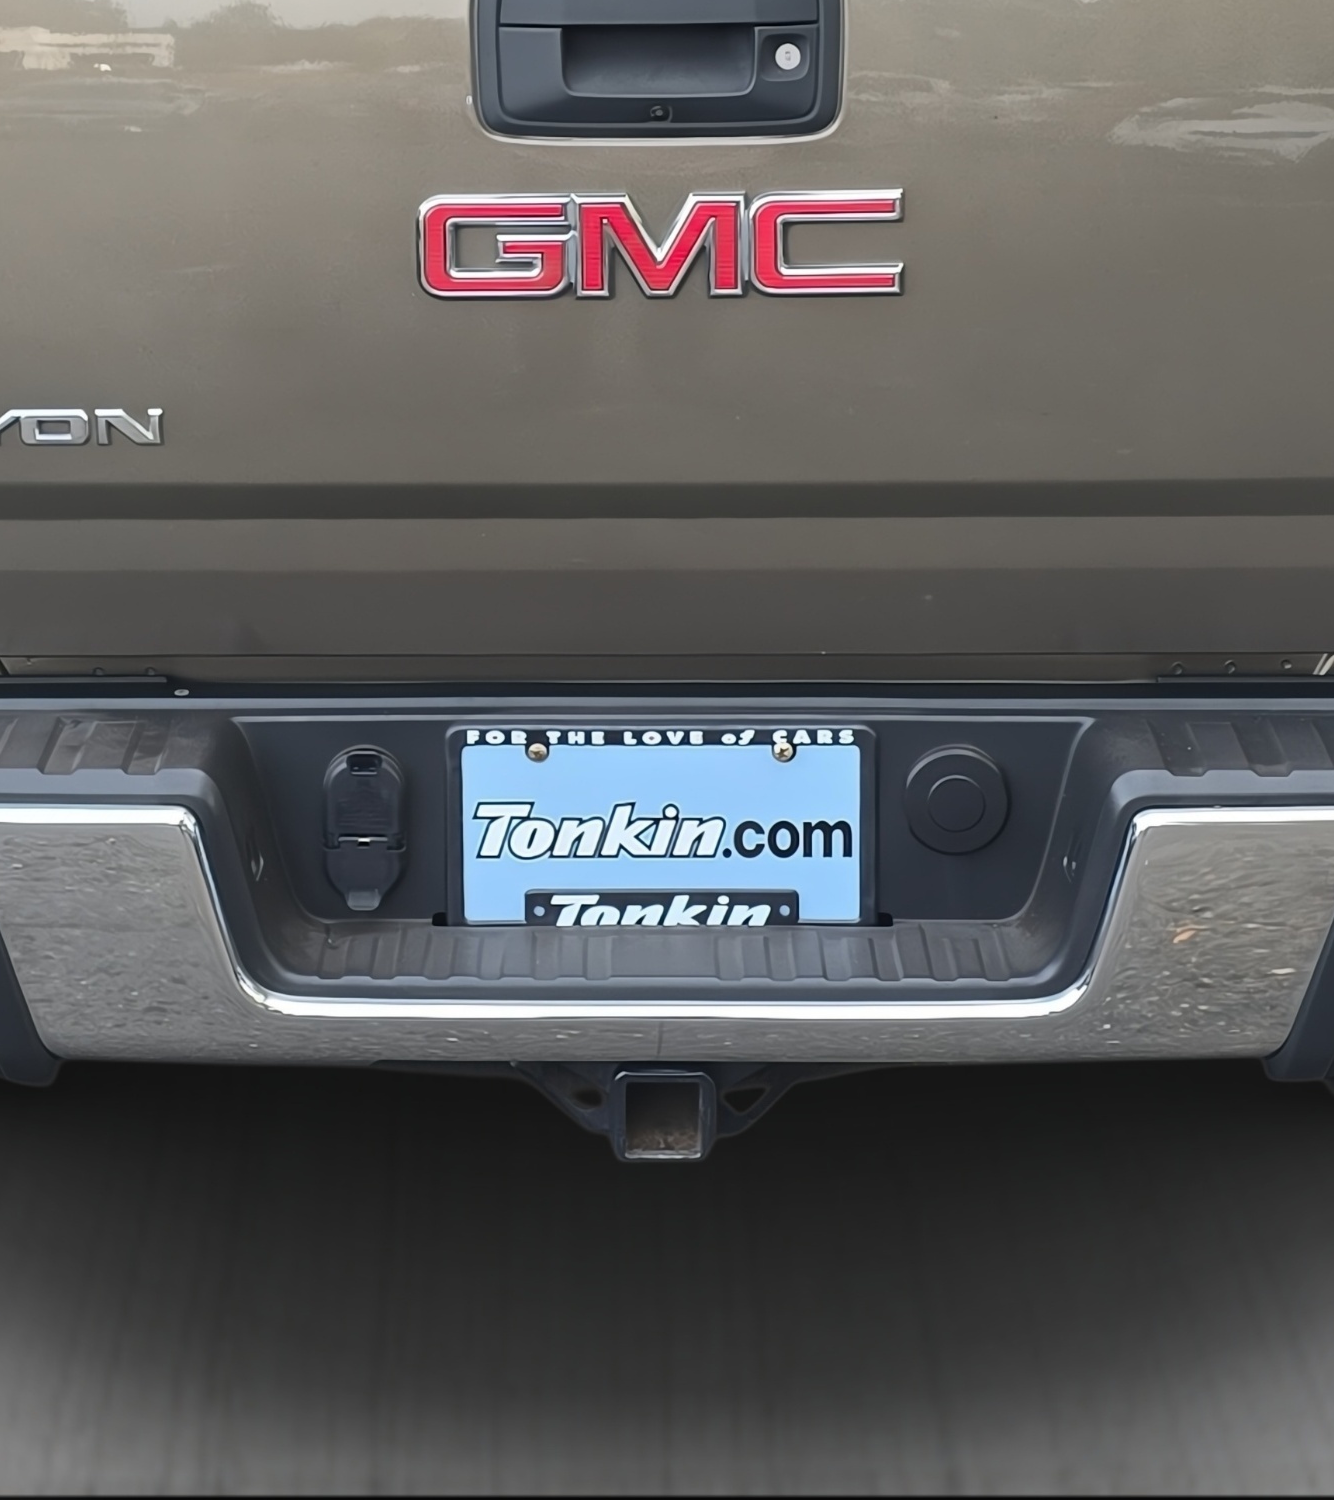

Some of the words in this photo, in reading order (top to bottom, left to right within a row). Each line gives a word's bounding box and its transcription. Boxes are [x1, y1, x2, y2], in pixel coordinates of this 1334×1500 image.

[417, 188, 903, 298] GMC
[466, 729, 527, 745] FOR
[546, 730, 605, 745] THE
[623, 730, 704, 745] LOVE
[772, 729, 855, 745] CARS
[472, 802, 853, 859] Tonkin.com
